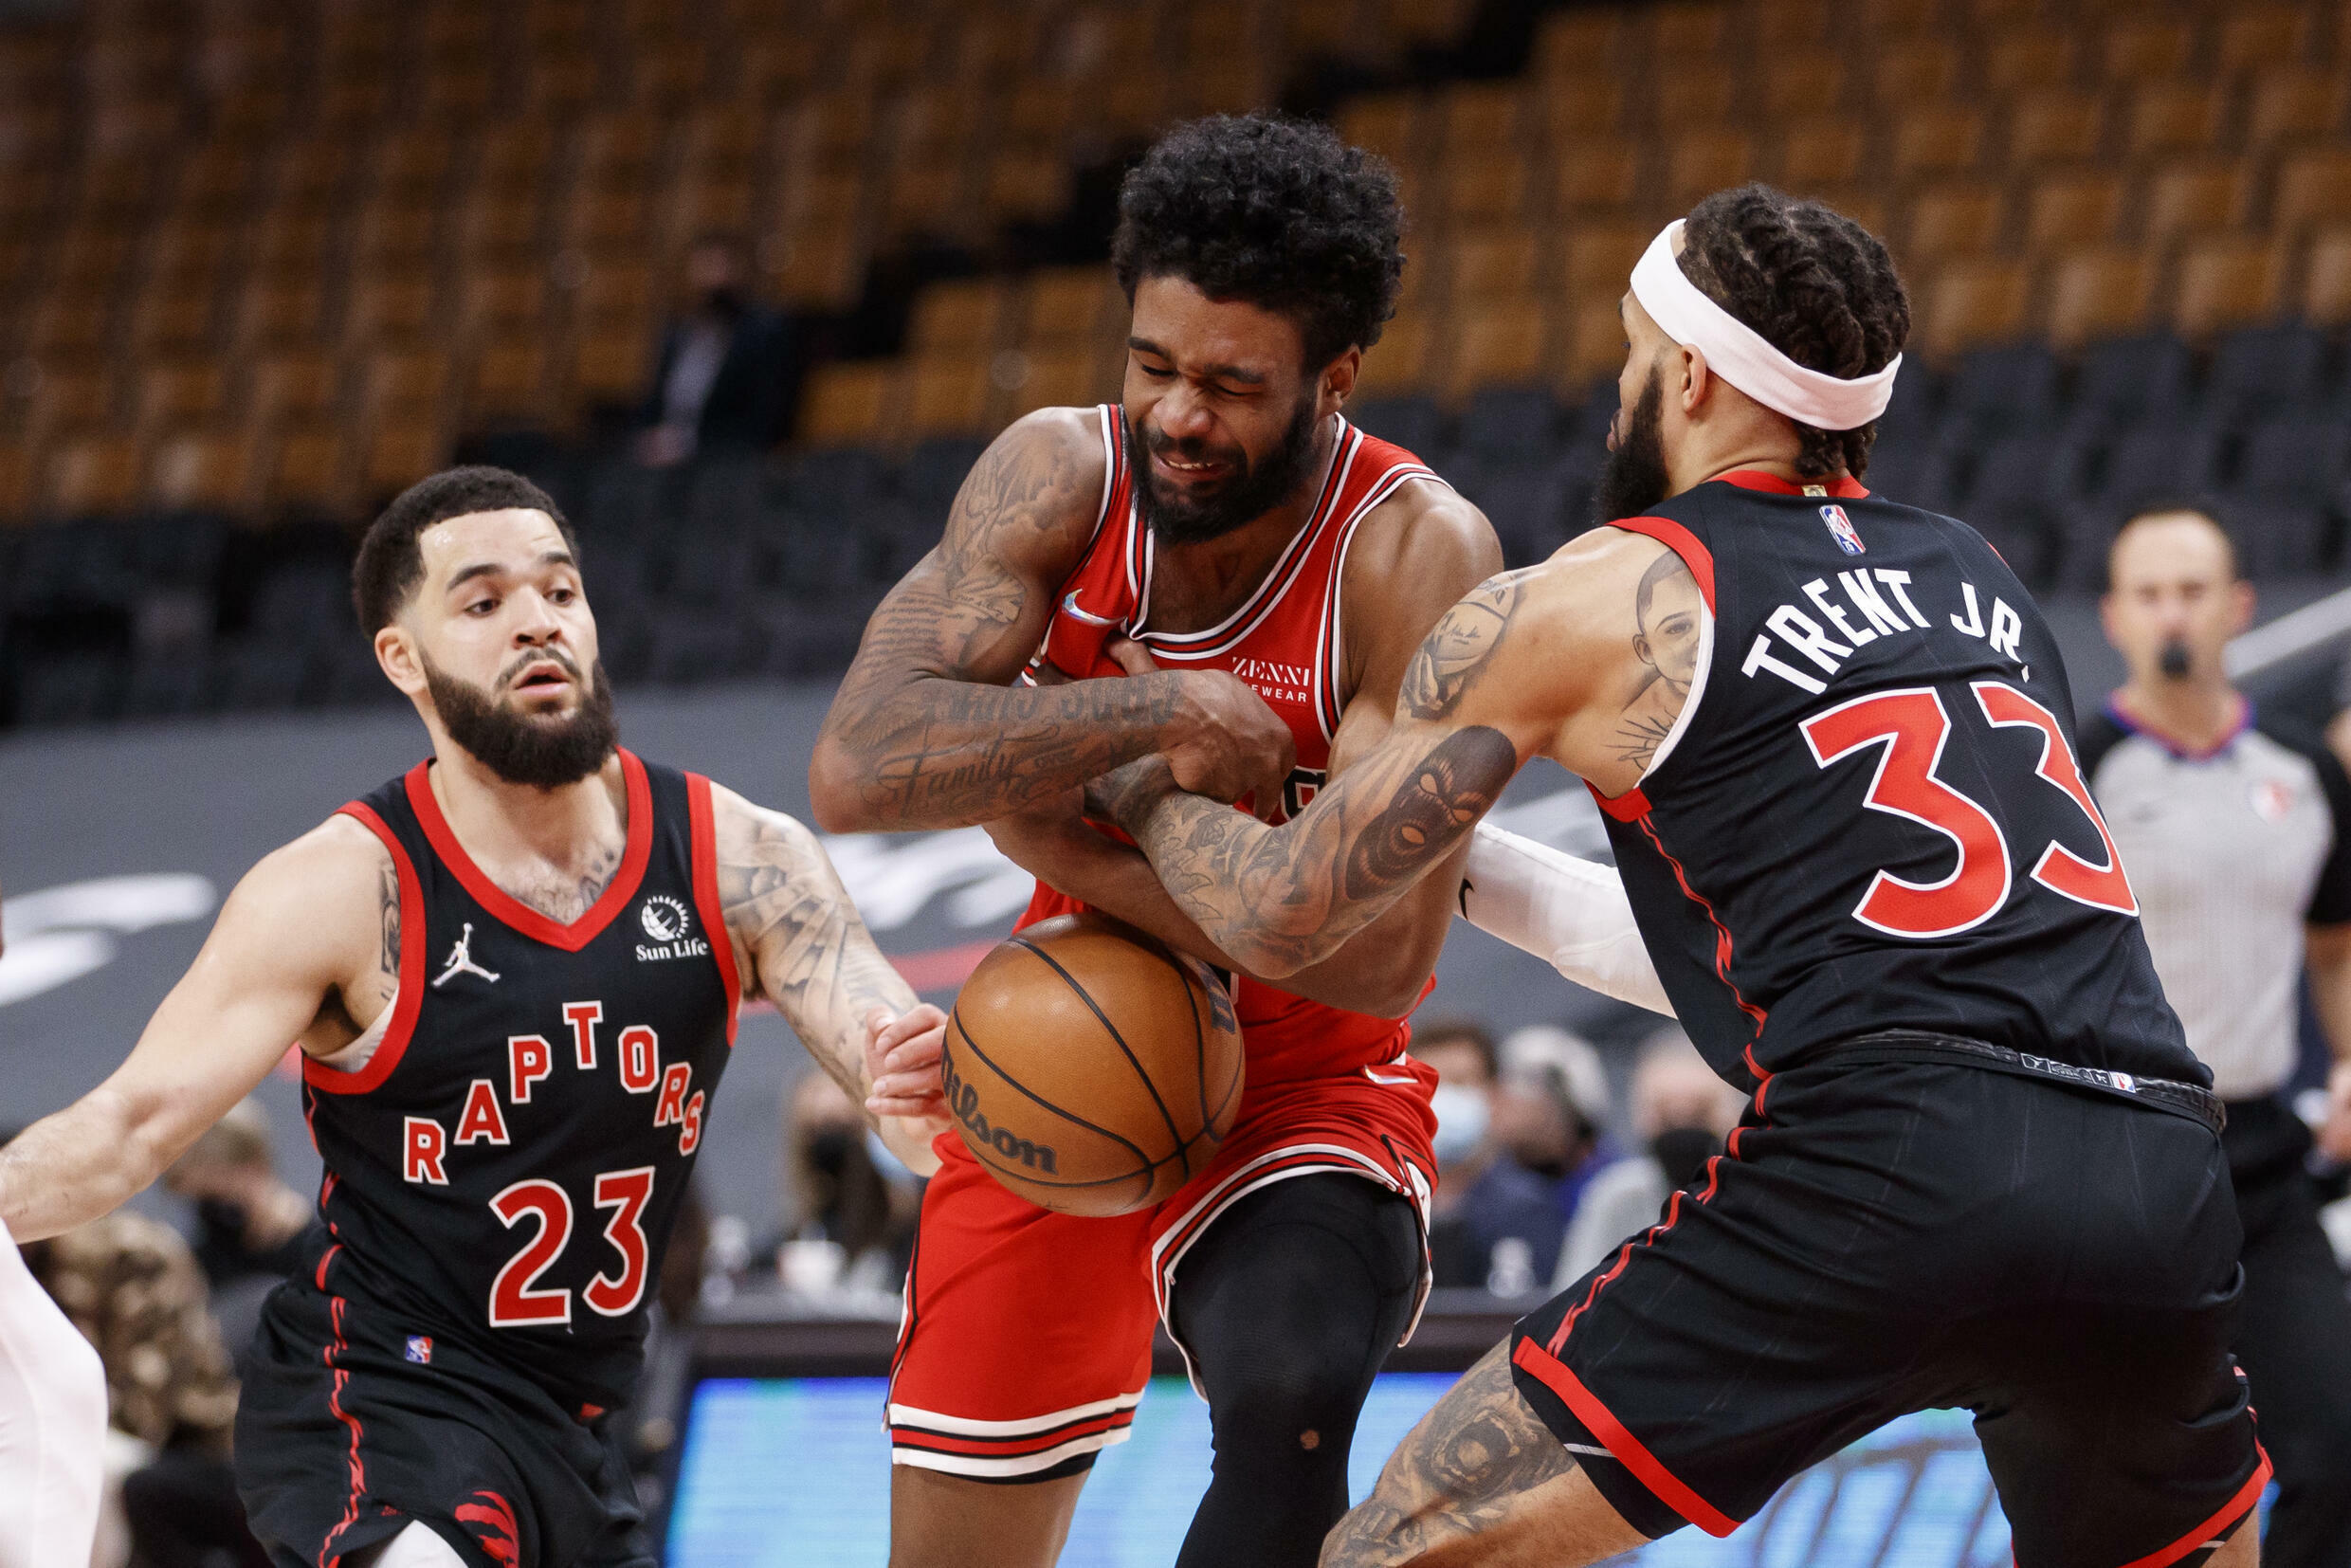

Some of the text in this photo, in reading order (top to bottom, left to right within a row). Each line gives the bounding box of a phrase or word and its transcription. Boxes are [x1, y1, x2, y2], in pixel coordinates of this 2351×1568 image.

[1232, 656, 1310, 687] ZENNI
[1245, 682, 1308, 703] EWEAR
[1740, 568, 1932, 695] TRENT
[1798, 681, 2141, 939] 33
[635, 937, 709, 962] Sun Life
[403, 1001, 704, 1186] RAPTORS
[487, 1166, 656, 1327] 23
